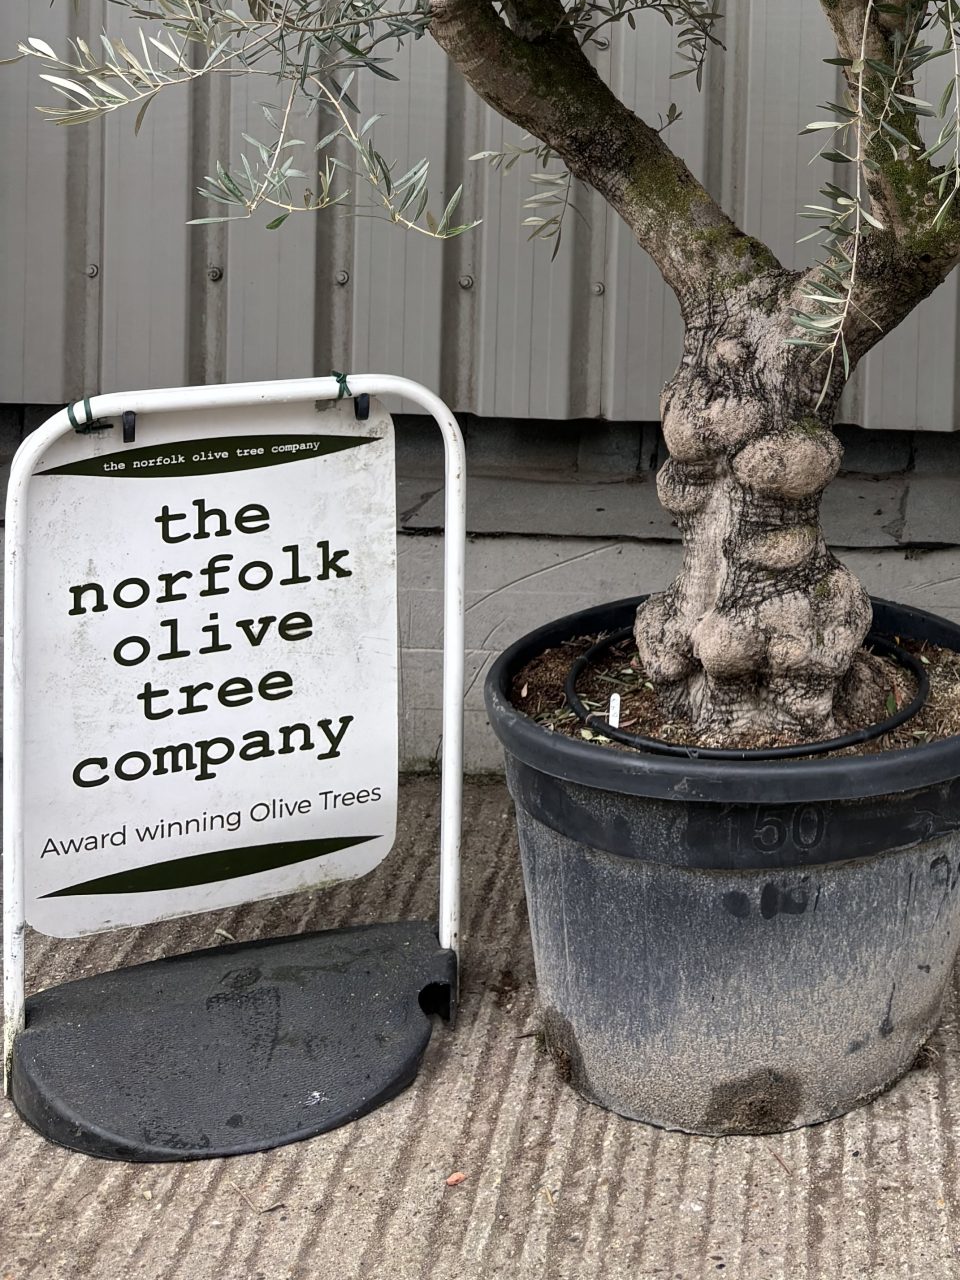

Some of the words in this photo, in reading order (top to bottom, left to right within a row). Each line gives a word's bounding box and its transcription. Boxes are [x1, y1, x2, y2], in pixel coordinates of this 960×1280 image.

[103, 460, 126, 472] the
[133, 454, 186, 469] norfolk
[192, 450, 229, 462] olive
[236, 446, 265, 458] tree
[271, 441, 321, 455] company
[154, 499, 270, 544] the
[68, 540, 353, 616] norfolk
[113, 611, 313, 667] olive
[136, 670, 293, 721] tree
[72, 715, 354, 788] company
[40, 824, 127, 859] Award
[135, 808, 242, 842] winning
[249, 796, 312, 822] Olive
[319, 785, 382, 810] Trees
